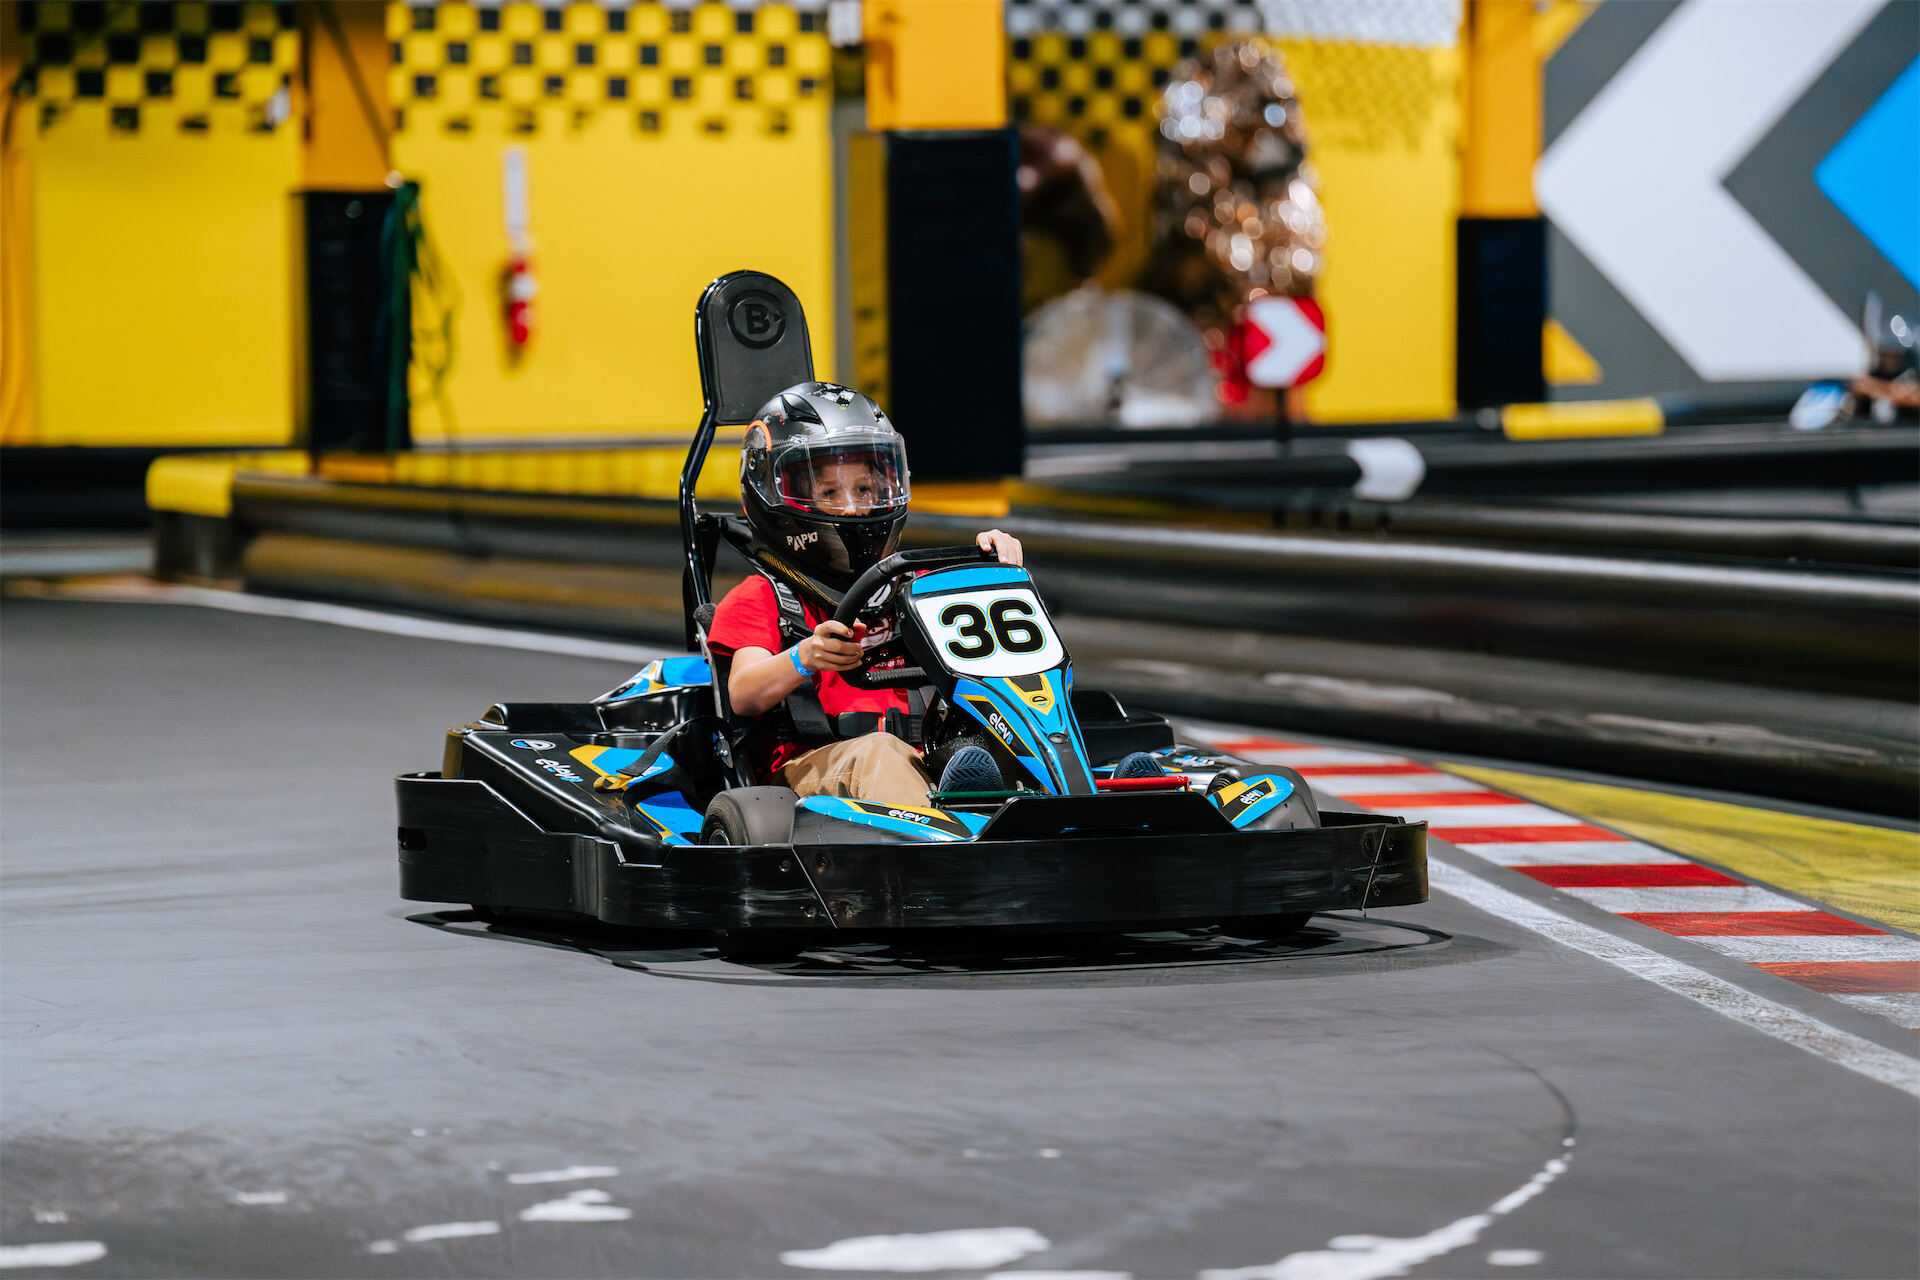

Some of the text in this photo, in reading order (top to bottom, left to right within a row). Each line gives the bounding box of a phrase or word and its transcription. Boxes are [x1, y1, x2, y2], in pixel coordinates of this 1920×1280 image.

[744, 303, 771, 335] B
[939, 597, 1046, 661] 36
[989, 712, 1014, 746] elev8
[888, 809, 931, 825] elev8
